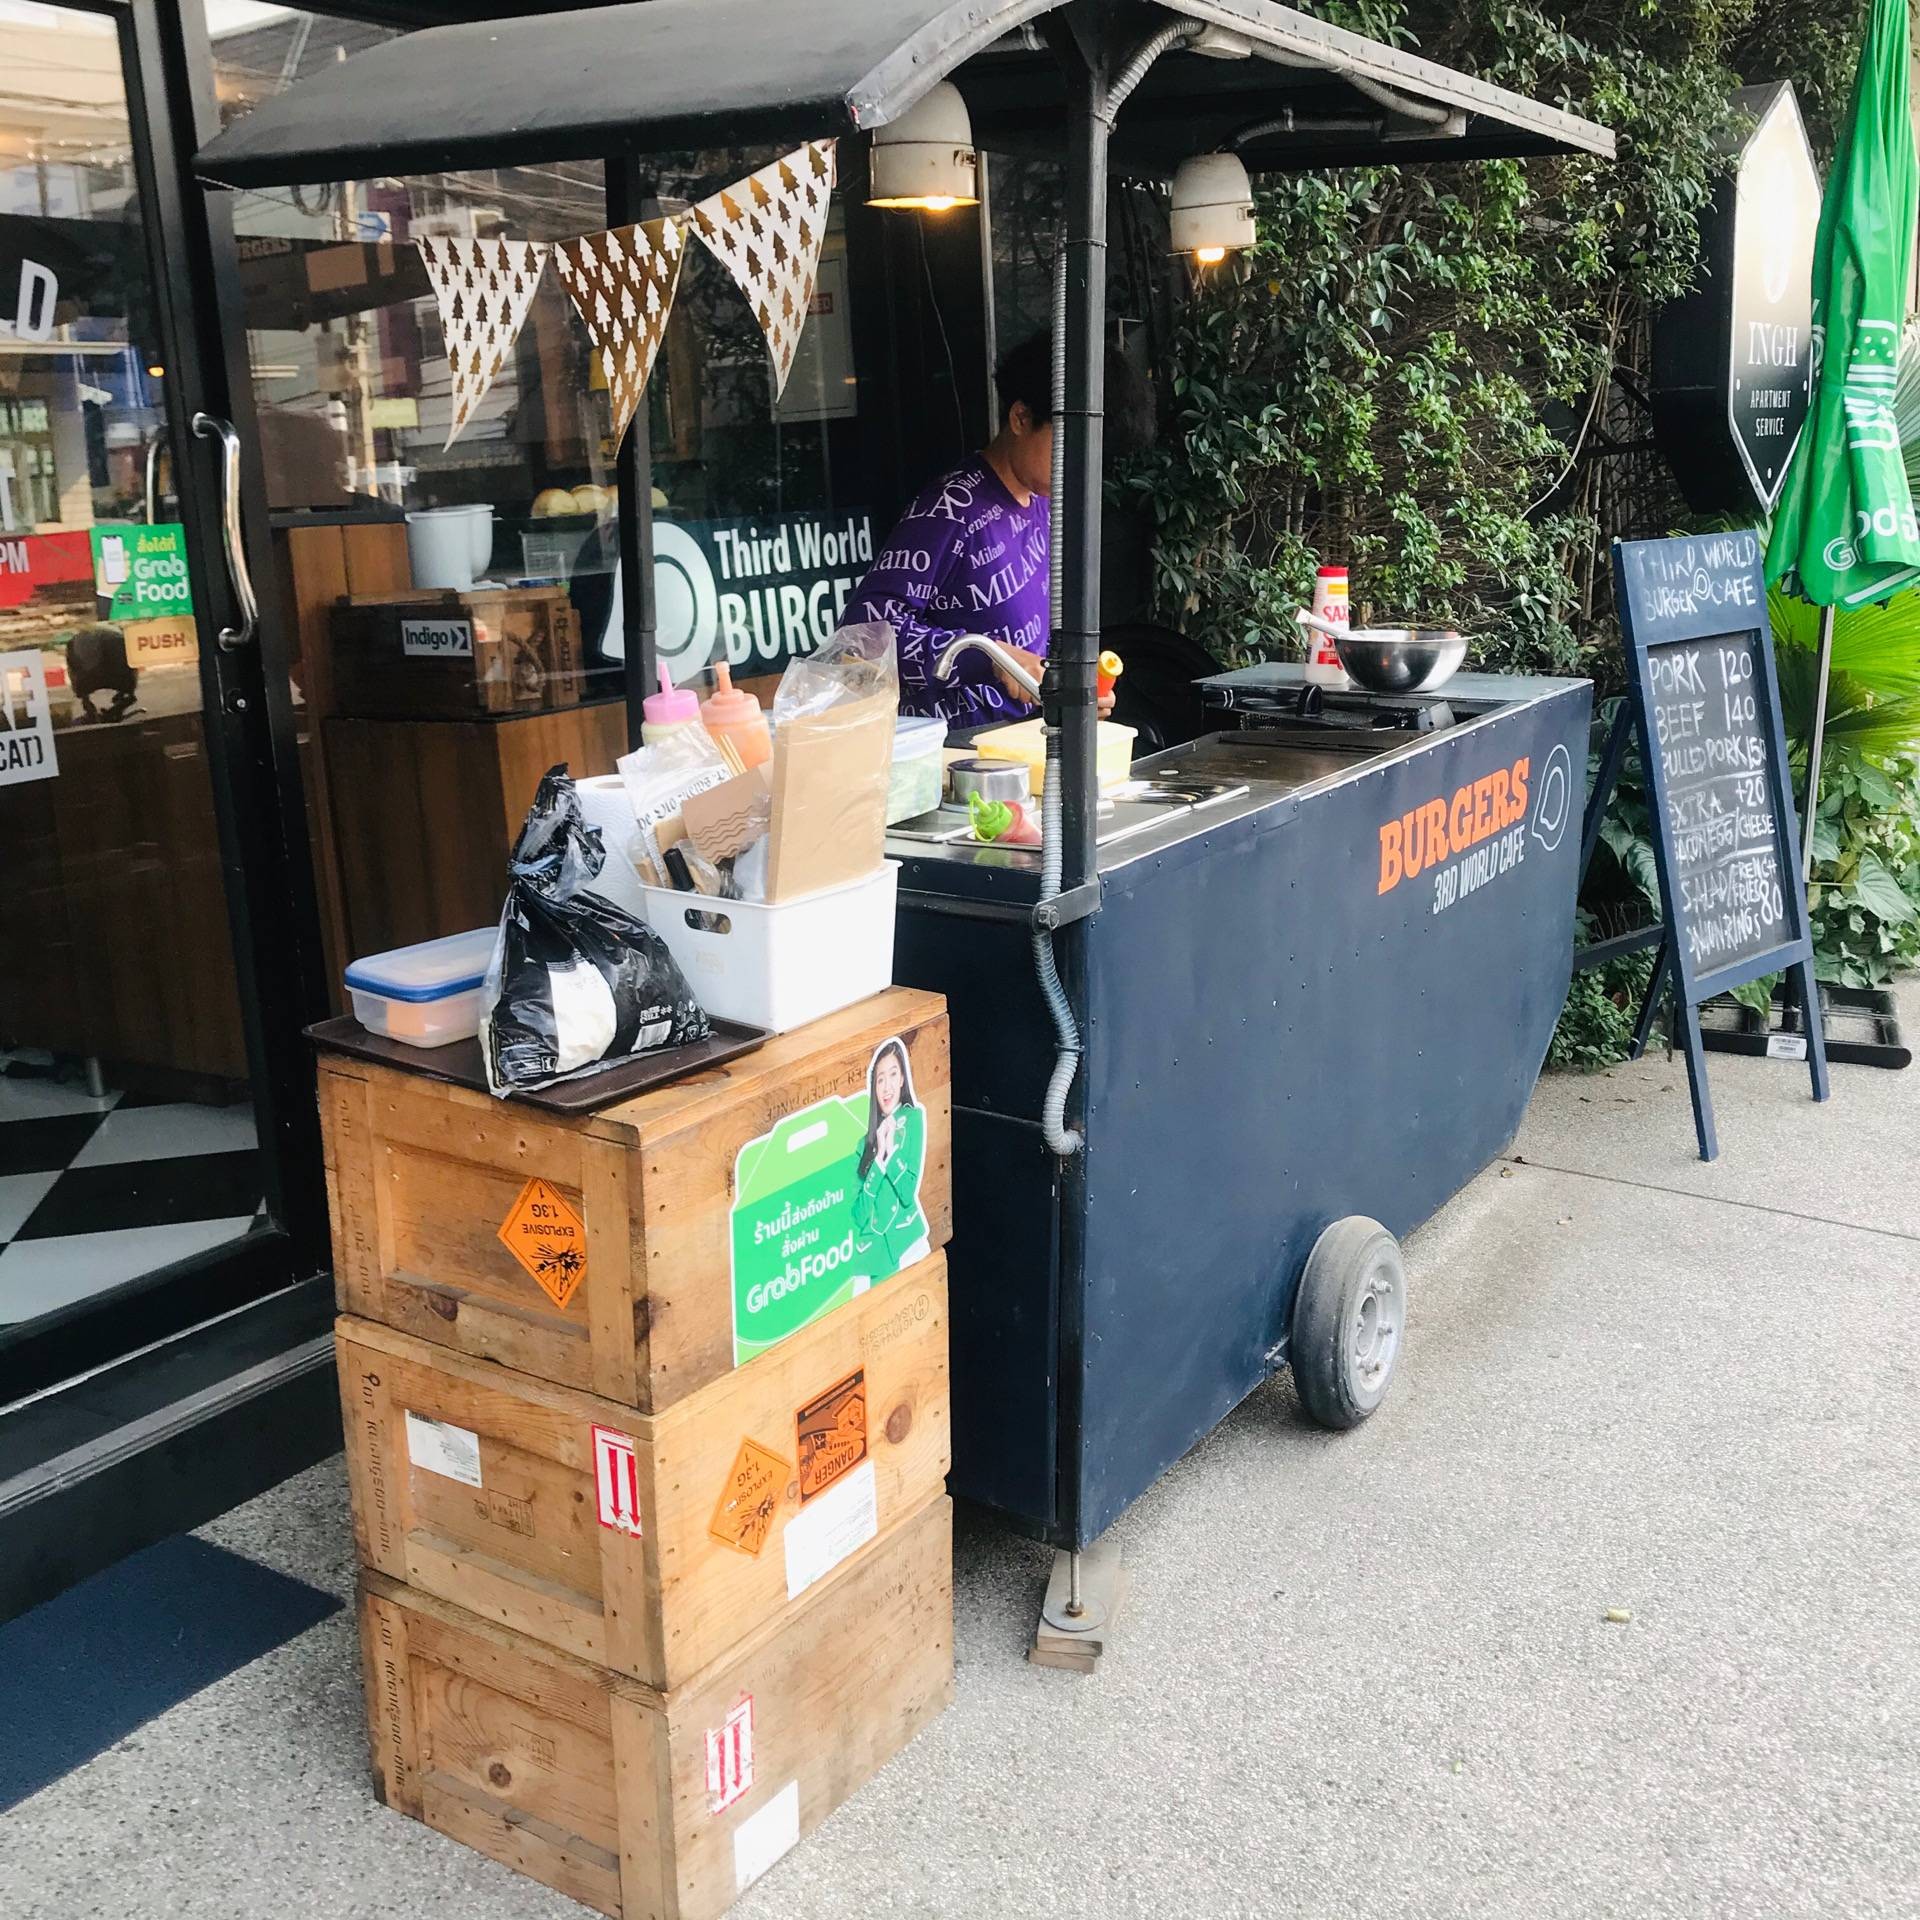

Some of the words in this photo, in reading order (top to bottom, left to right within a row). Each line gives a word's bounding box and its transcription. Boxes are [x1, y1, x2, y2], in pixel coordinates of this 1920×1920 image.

[1750, 390, 1791, 409] APARTMENT
[1755, 417, 1785, 437] SERVICE
[714, 524, 792, 580] Third
[794, 516, 873, 570] World
[1701, 535, 1756, 569] WORLD
[134, 553, 186, 581] Grab
[966, 526, 1047, 613] MILANO
[135, 577, 188, 603] Food
[1709, 574, 1757, 607] CAFE
[137, 633, 187, 651] PUSH
[405, 626, 449, 650] Indigo
[1648, 648, 1706, 696] PORK
[1719, 648, 1752, 690] 120
[1655, 701, 1705, 745] BEEF
[1724, 692, 1756, 732] 140
[1704, 734, 1748, 769] PORK
[1735, 775, 1766, 807] +20
[1377, 756, 1531, 896] BURGERS
[1433, 865, 1459, 915] 3RD
[1459, 841, 1498, 899] WORLD
[1499, 824, 1526, 875] CAFE
[1759, 879, 1783, 926] 80
[531, 1203, 559, 1218] 1.3G
[522, 1223, 575, 1237] EXPLOSIVE
[746, 1228, 854, 1314] GrabFood
[737, 1463, 761, 1488] 1.3G
[814, 1446, 855, 1486] DANGER
